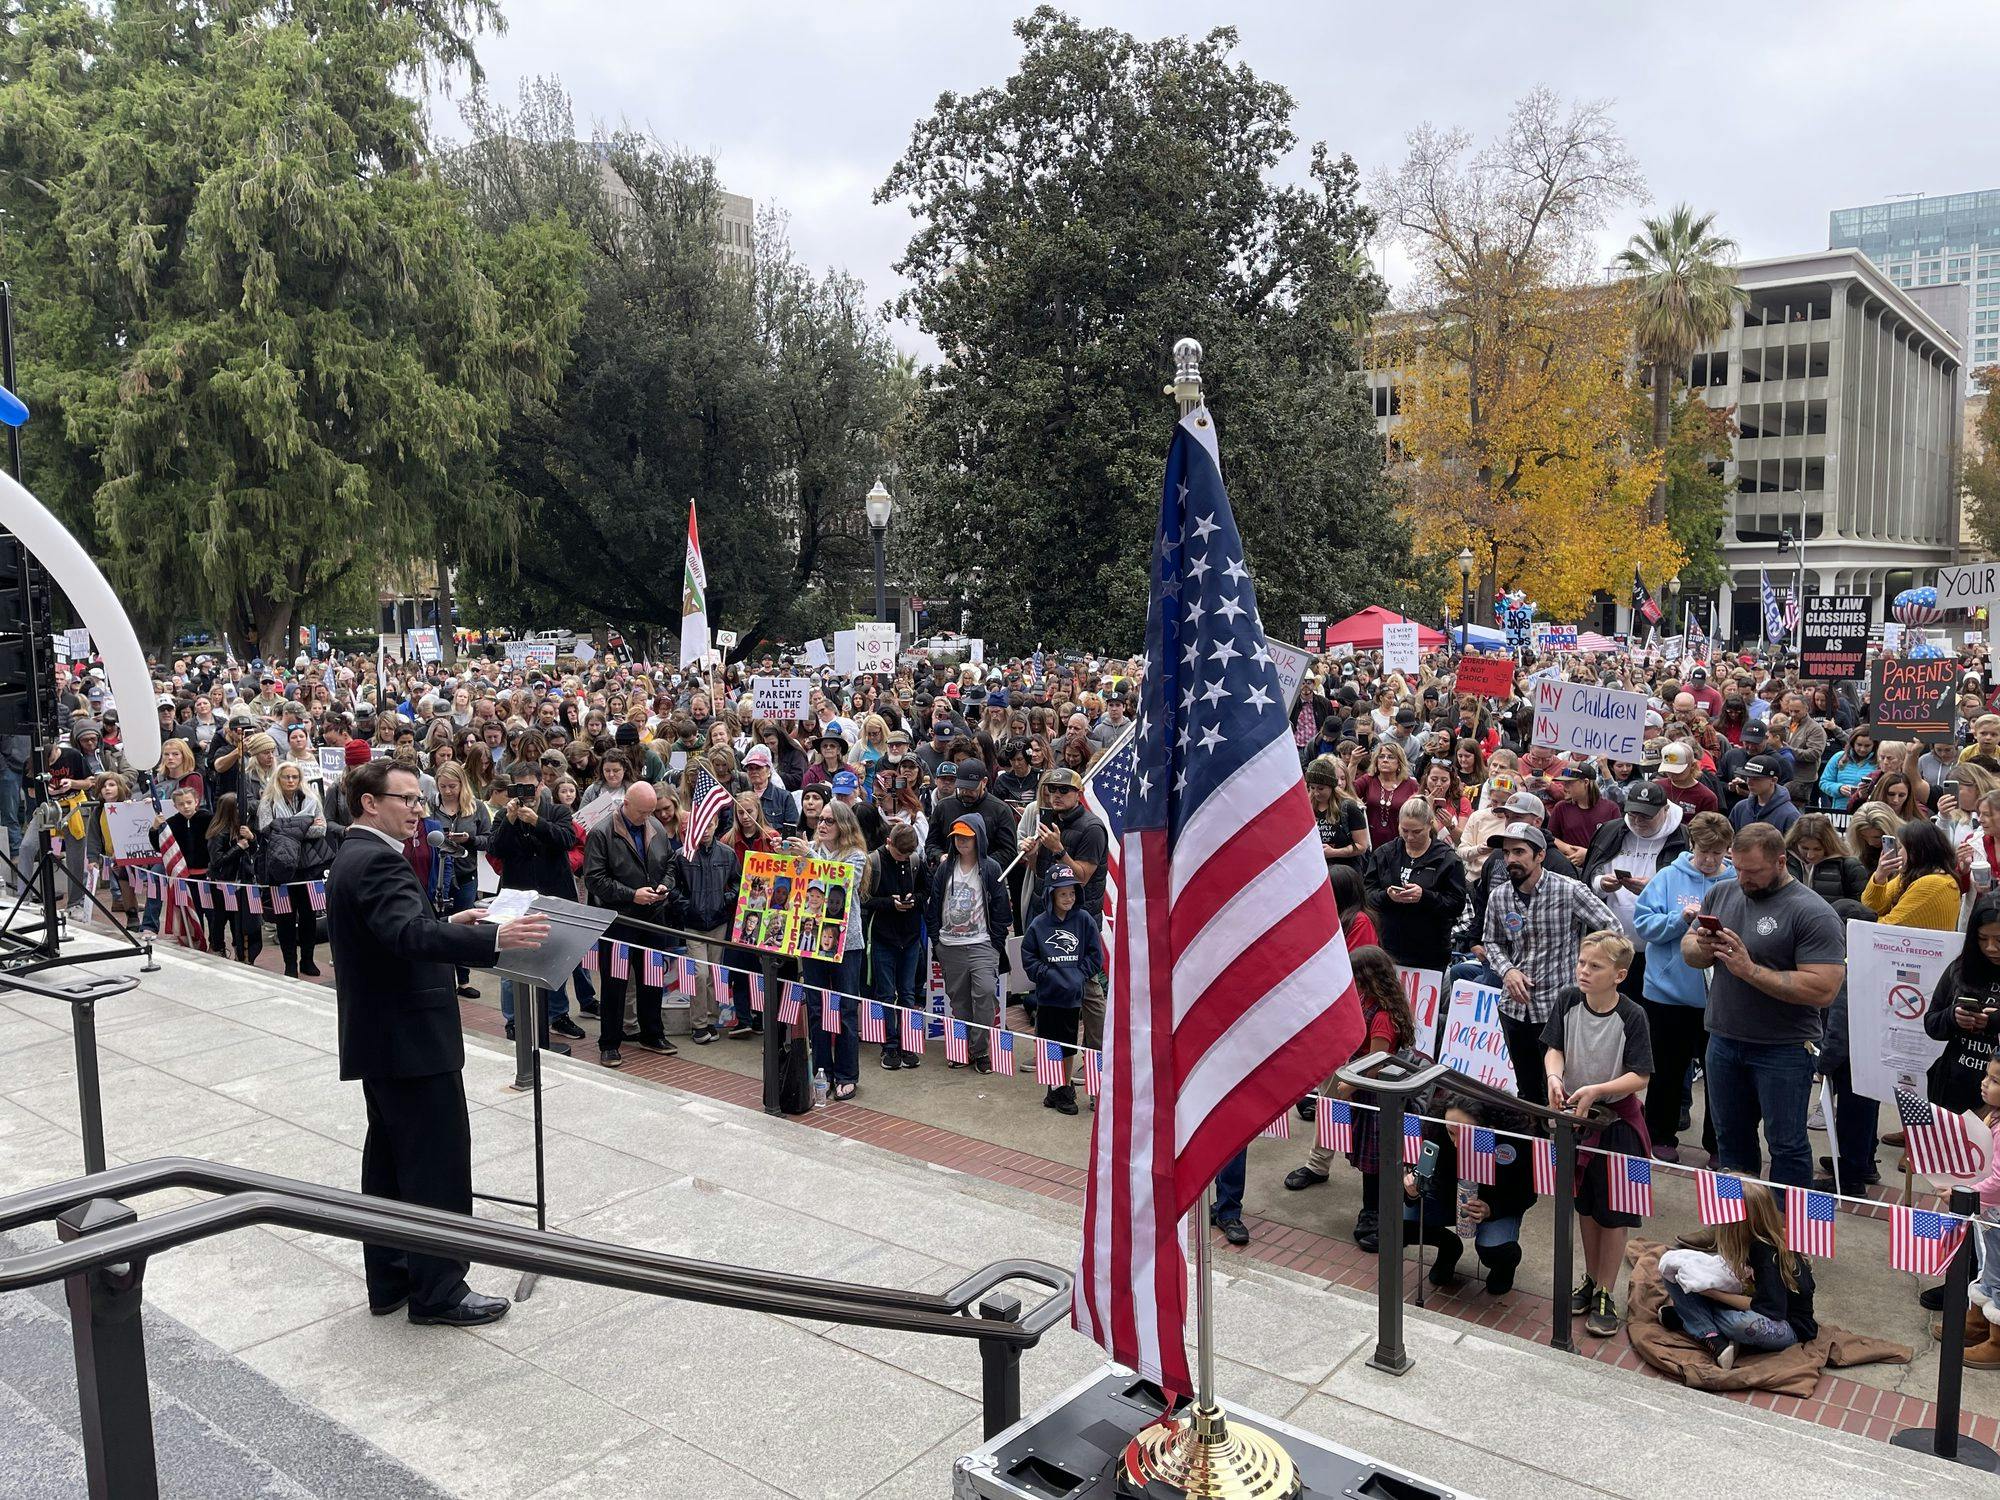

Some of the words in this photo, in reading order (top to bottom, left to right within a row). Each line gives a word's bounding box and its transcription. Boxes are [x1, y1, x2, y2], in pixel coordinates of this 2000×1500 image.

[1941, 568, 1995, 598] YOUR
[1810, 598, 1833, 610] U.S.
[1835, 598, 1864, 610] LAW
[1508, 611, 1527, 620] NO
[1805, 612, 1866, 623] CLASSIFIES
[1507, 619, 1530, 629] JABS
[1550, 627, 1564, 635] NO
[1805, 625, 1866, 637] VACCINES
[1507, 637, 1531, 645] JOBS
[1538, 634, 1577, 643] FORCED
[1825, 638, 1843, 651] AS
[1803, 652, 1863, 661] UNAVOIDABLY
[858, 661, 878, 671] LAB
[1809, 664, 1855, 675] UNSAFE
[760, 690, 802, 698] PARENTS
[755, 700, 778, 709] CALL
[783, 700, 800, 709] THE
[763, 710, 796, 718] SHOTS
[1571, 726, 1636, 753] CHOICE
[749, 858, 788, 873] THESE
[809, 862, 846, 879] LIVES
[787, 877, 806, 956] MATTER
[1873, 943, 1905, 953] MEDICAL
[1906, 946, 1943, 957] FREEDOM
